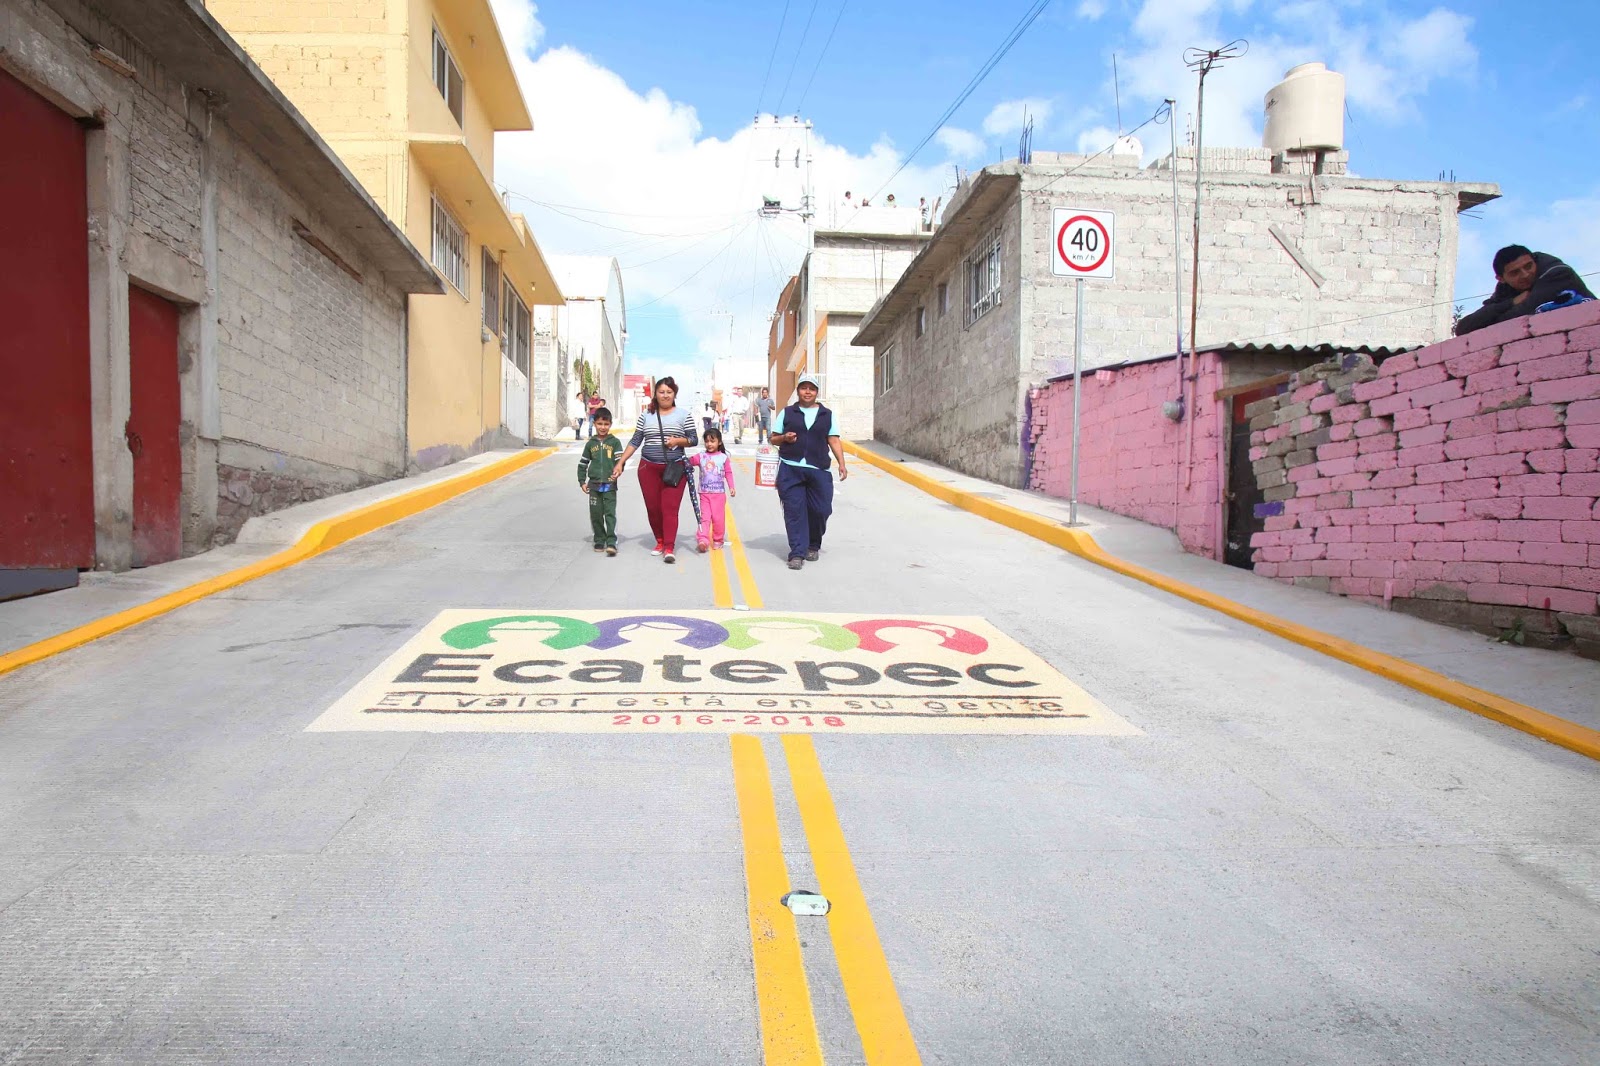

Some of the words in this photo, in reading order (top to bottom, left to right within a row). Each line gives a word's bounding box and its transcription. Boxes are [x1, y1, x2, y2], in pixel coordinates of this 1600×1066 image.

[1071, 227, 1098, 252] 40
[392, 653, 1041, 691] Ecatepec
[376, 692, 426, 708] El
[456, 695, 588, 708] valor
[617, 695, 725, 708] está
[757, 699, 812, 709] en
[845, 700, 893, 711] su
[923, 699, 1063, 713] gente
[613, 714, 846, 727] 2016-2018
